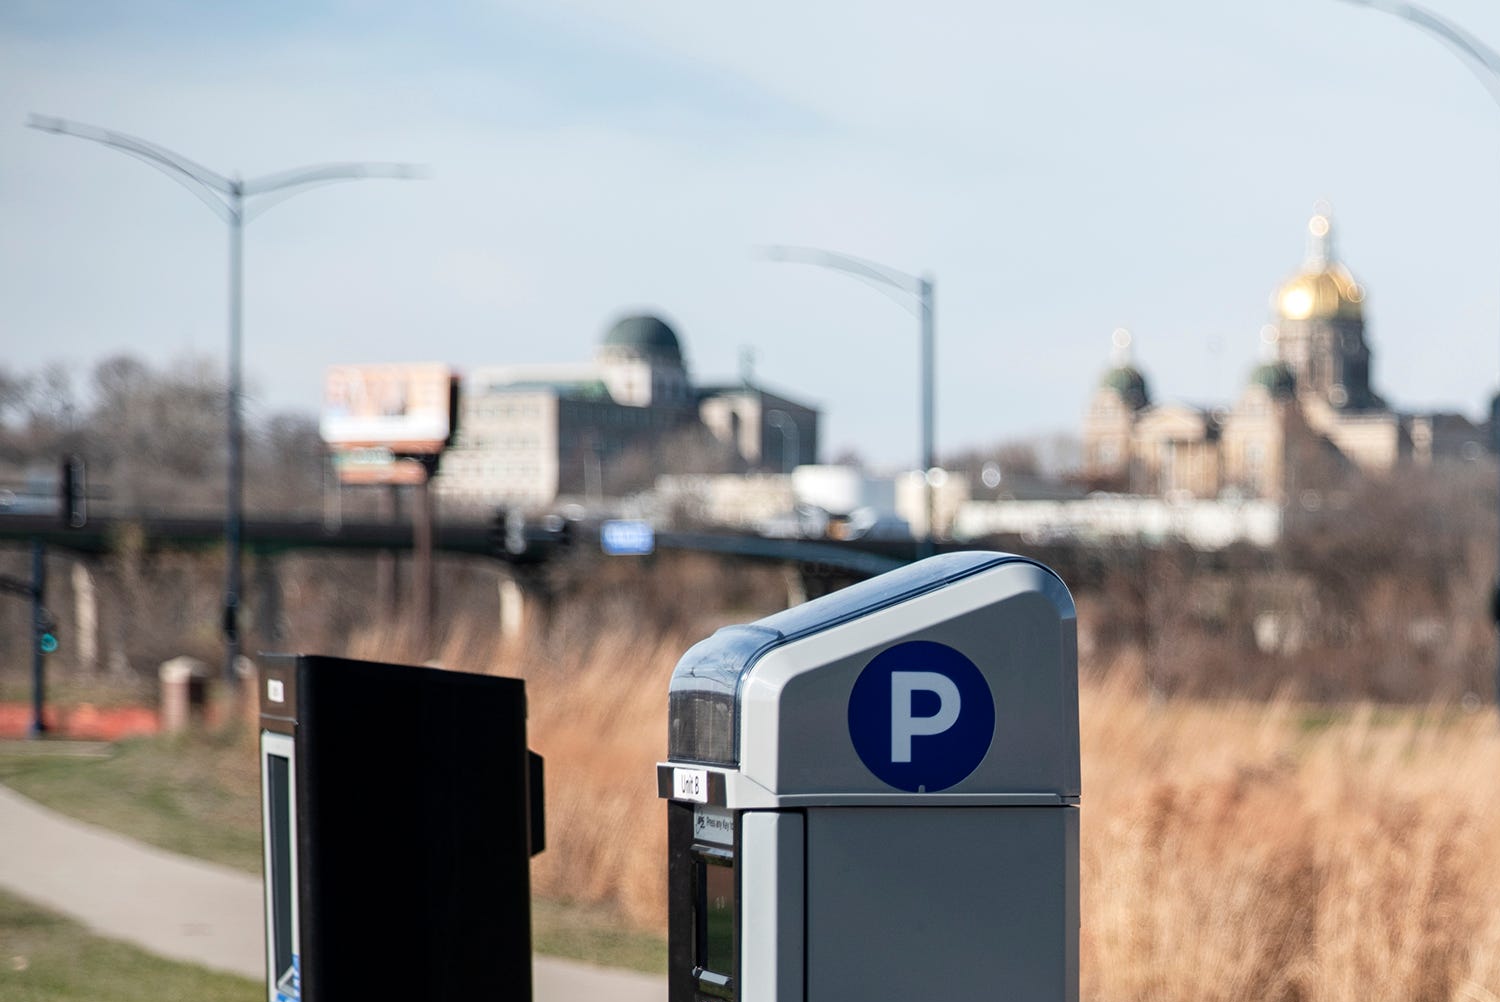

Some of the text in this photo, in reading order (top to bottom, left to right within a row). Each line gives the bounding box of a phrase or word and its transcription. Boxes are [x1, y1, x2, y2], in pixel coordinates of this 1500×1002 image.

[891, 671, 962, 763] P
[681, 773, 700, 795] Unit B
